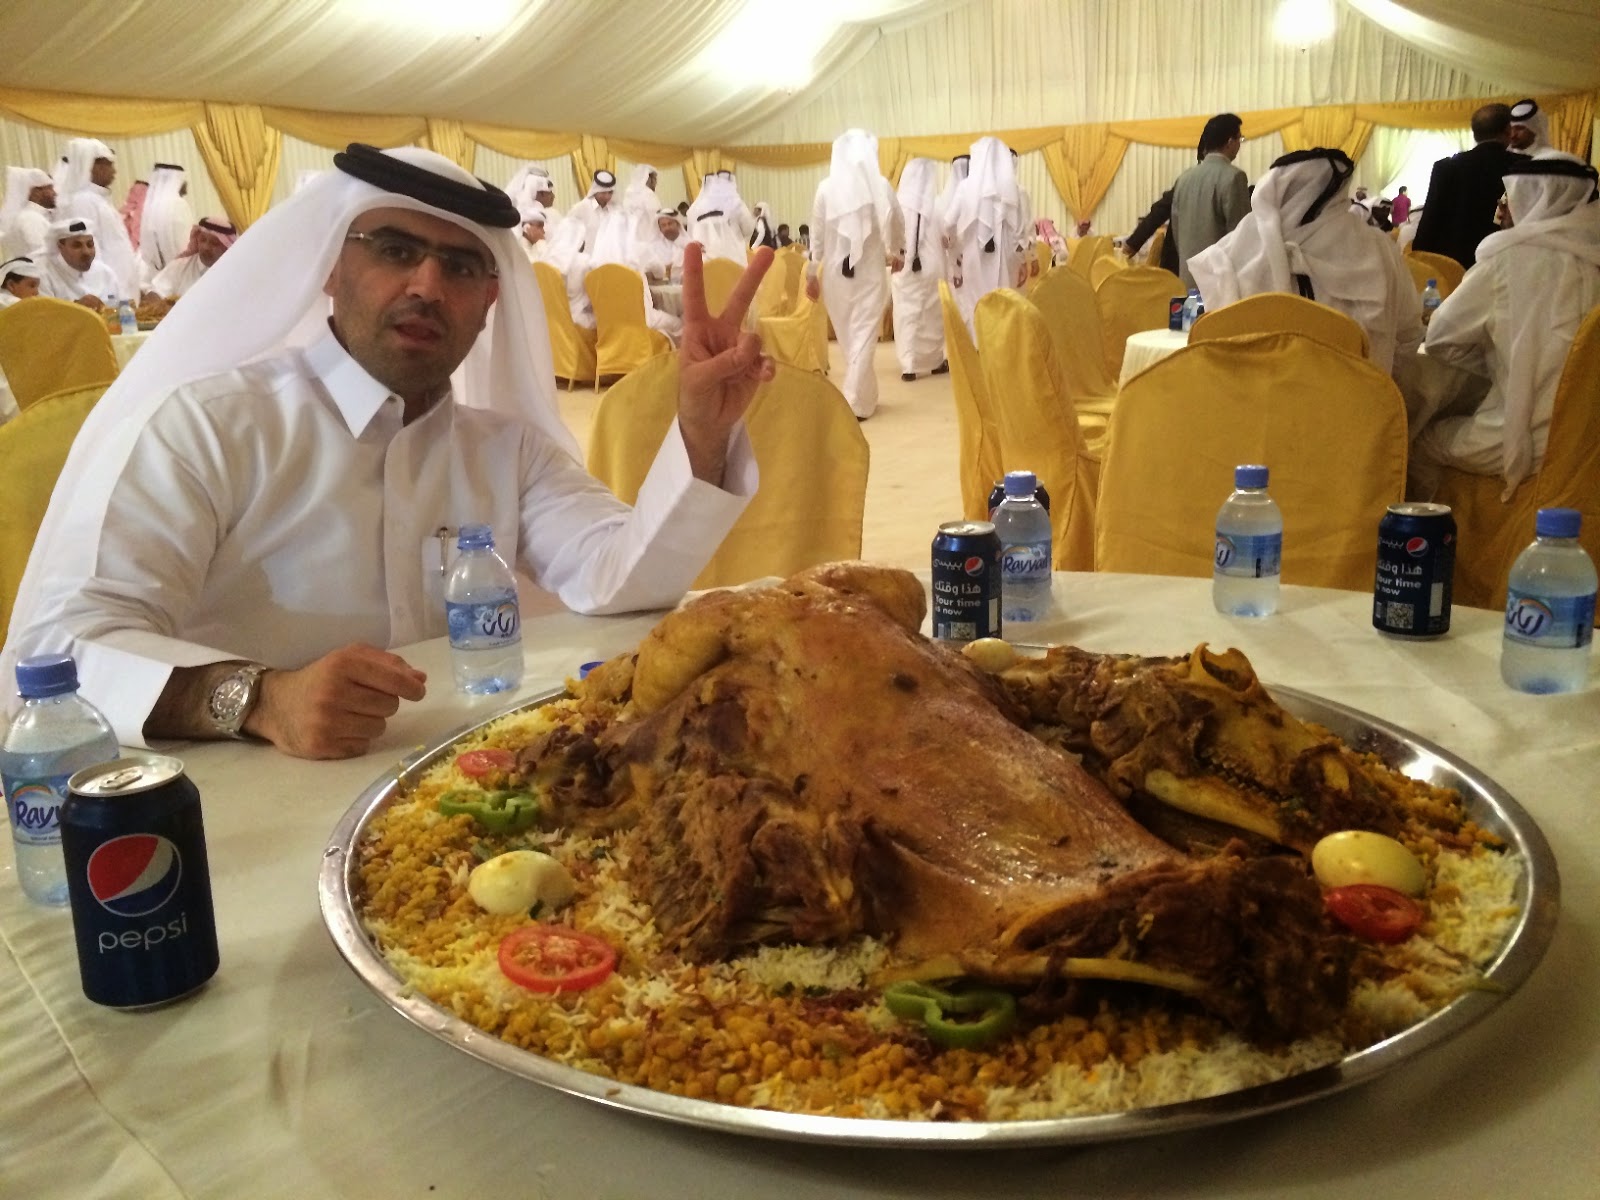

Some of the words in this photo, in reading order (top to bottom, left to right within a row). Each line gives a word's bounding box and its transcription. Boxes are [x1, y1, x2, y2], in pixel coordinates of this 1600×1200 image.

[934, 580, 959, 596] وقتك
[961, 582, 981, 594] هذا
[1395, 577, 1422, 588] time
[935, 593, 954, 606] Your
[957, 597, 981, 607] time
[99, 912, 187, 954] pepsi
